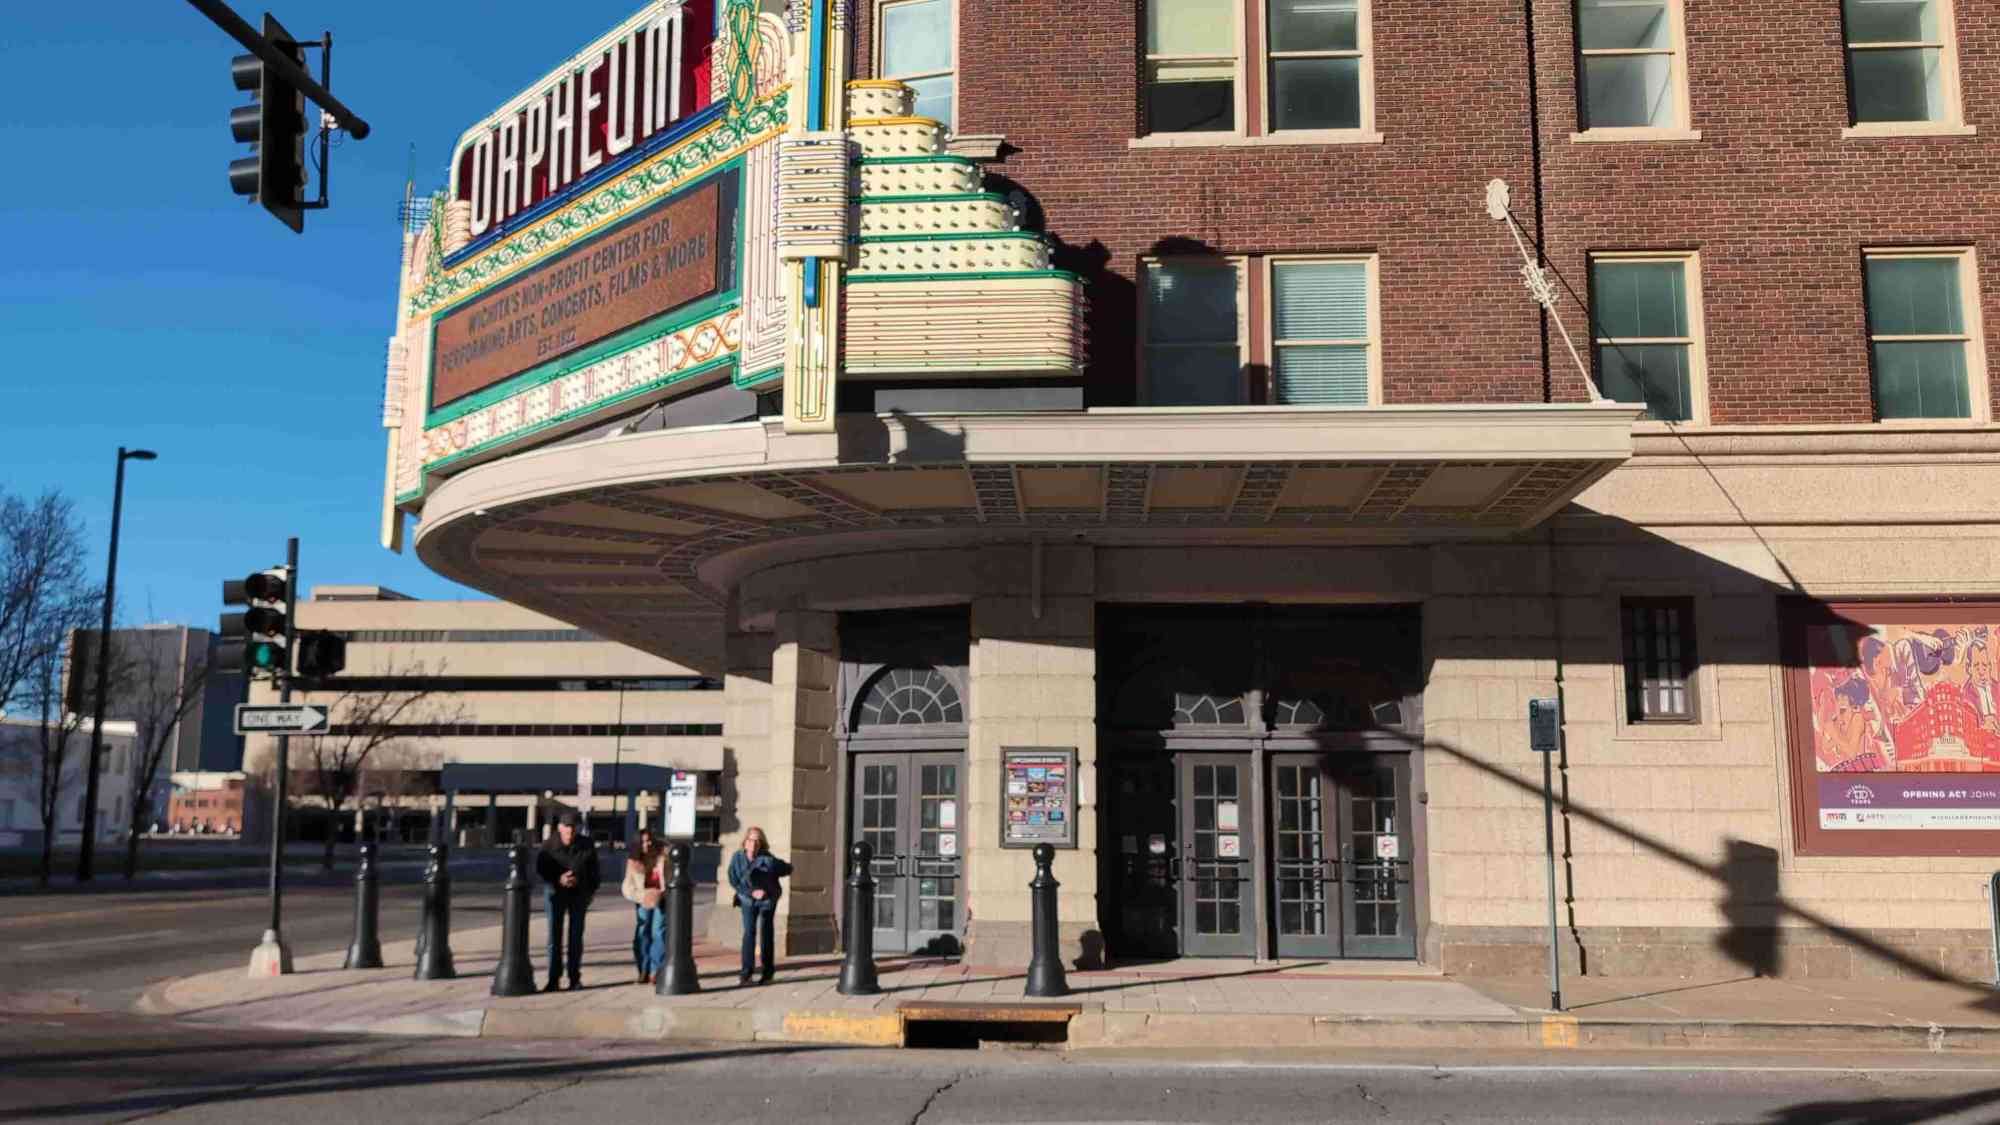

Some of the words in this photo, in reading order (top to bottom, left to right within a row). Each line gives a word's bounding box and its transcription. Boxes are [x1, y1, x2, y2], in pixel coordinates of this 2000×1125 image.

[470, 5, 683, 237] ORPHEUM
[441, 327, 505, 372] PERFORMING
[507, 313, 539, 345] ARTS,
[541, 283, 606, 330] CONCERTS,
[609, 261, 649, 299] FILMS
[651, 254, 661, 280] &
[665, 232, 708, 274] MORE
[468, 291, 521, 337] WICHITA'S
[522, 257, 590, 306] NON-PROFIT
[592, 232, 641, 274] CENTER
[642, 217, 671, 249] FOR
[247, 712, 270, 724] ONE
[276, 712, 301, 723] WAY
[1902, 790, 1945, 799] OPENING
[1948, 790, 1967, 799] ACT
[1970, 790, 1997, 799] JOHN
